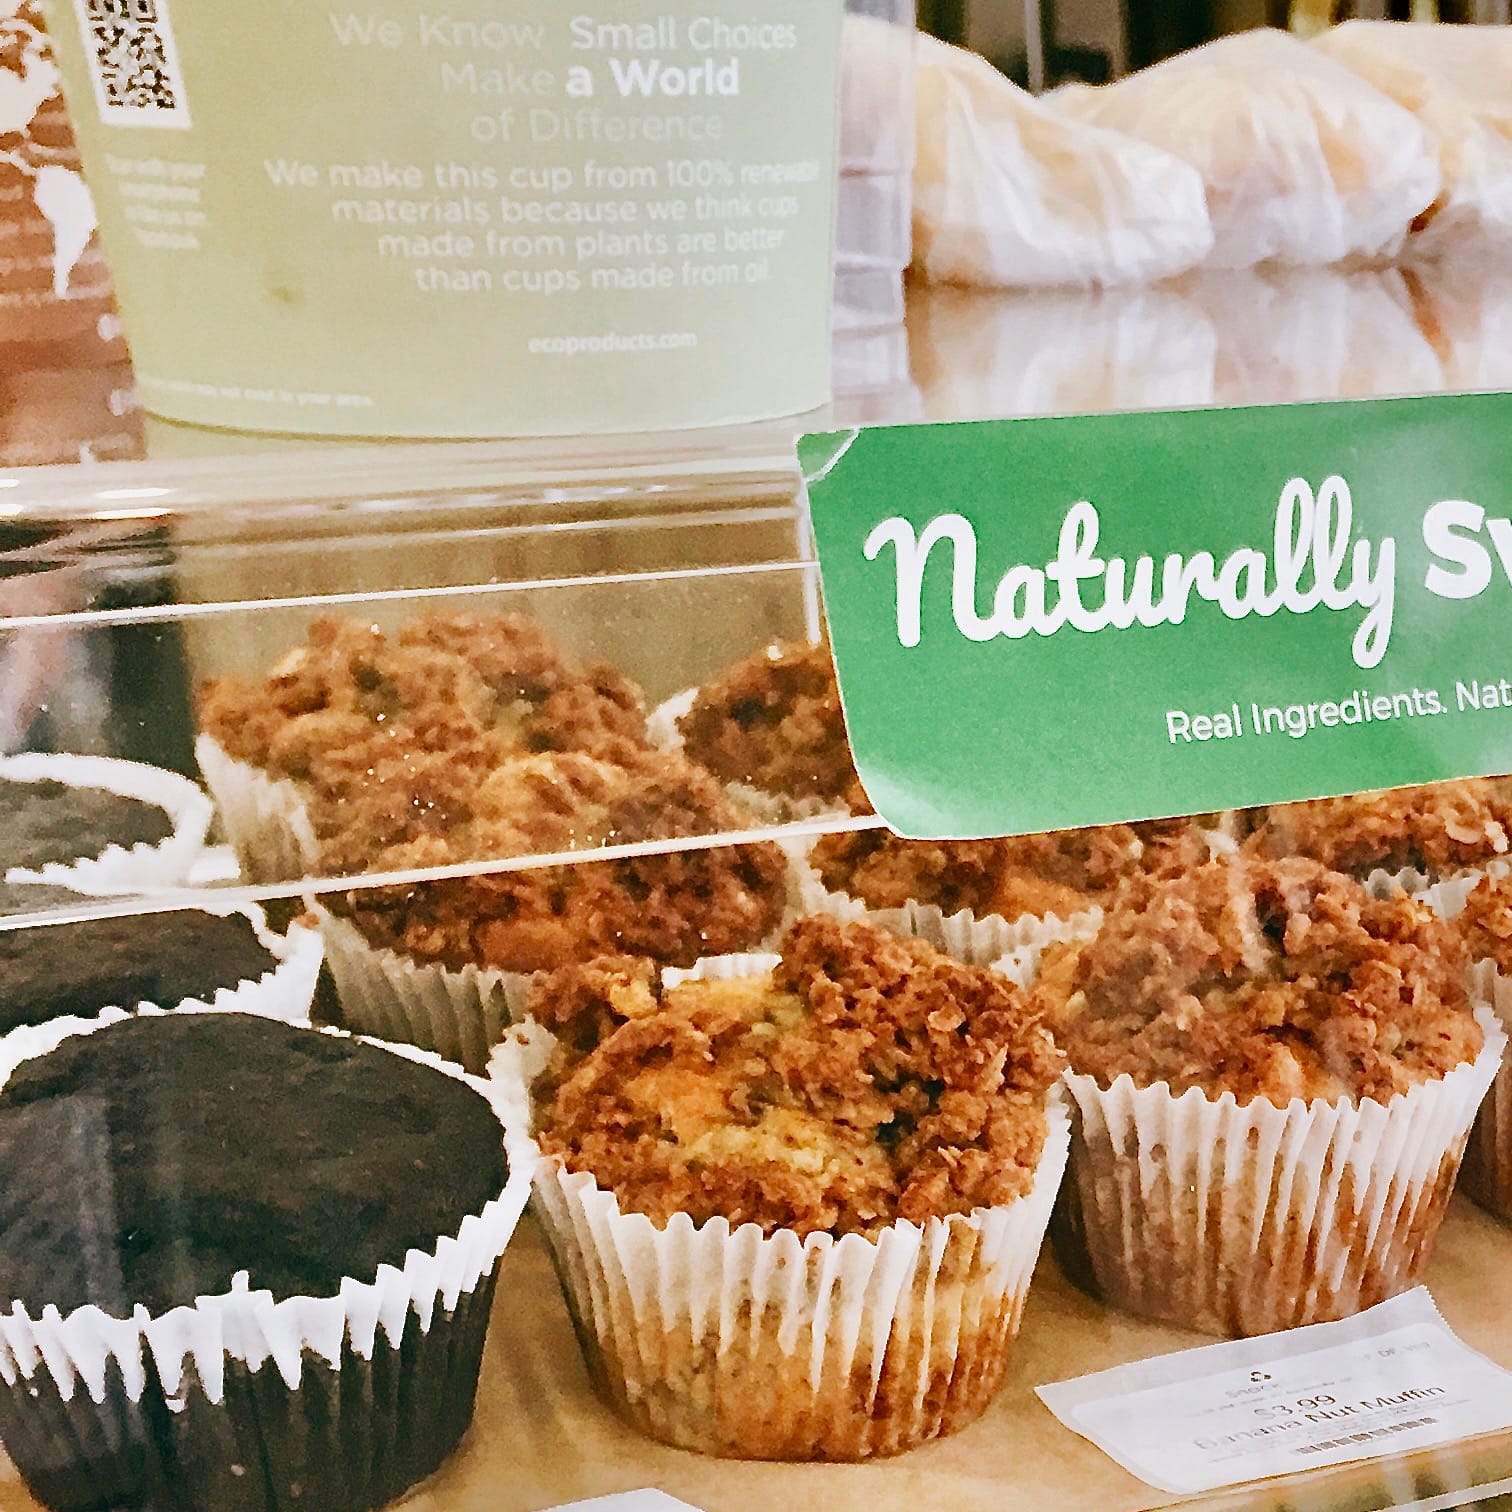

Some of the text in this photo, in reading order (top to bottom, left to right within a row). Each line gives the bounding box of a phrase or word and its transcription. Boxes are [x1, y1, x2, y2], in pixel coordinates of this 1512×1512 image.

[329, 13, 797, 51] We Know Small Choices
[440, 58, 739, 97] Make a World
[470, 107, 721, 141] of Difference
[264, 160, 319, 188] We
[329, 160, 423, 189] make
[435, 161, 498, 190] this
[510, 164, 572, 193] cup
[584, 160, 655, 189] from
[332, 193, 752, 224] materials because we think
[378, 230, 716, 263] made from plants are
[416, 258, 738, 295] than cups made from
[528, 333, 696, 355] ecoproducts.com
[862, 475, 1396, 669] Naturally
[1167, 704, 1241, 744] Real
[1252, 689, 1446, 739] Ingredients.
[1254, 1394, 1336, 1420] $3.99
[1304, 1404, 1360, 1423] Nut
[1360, 1386, 1446, 1410] Muffin
